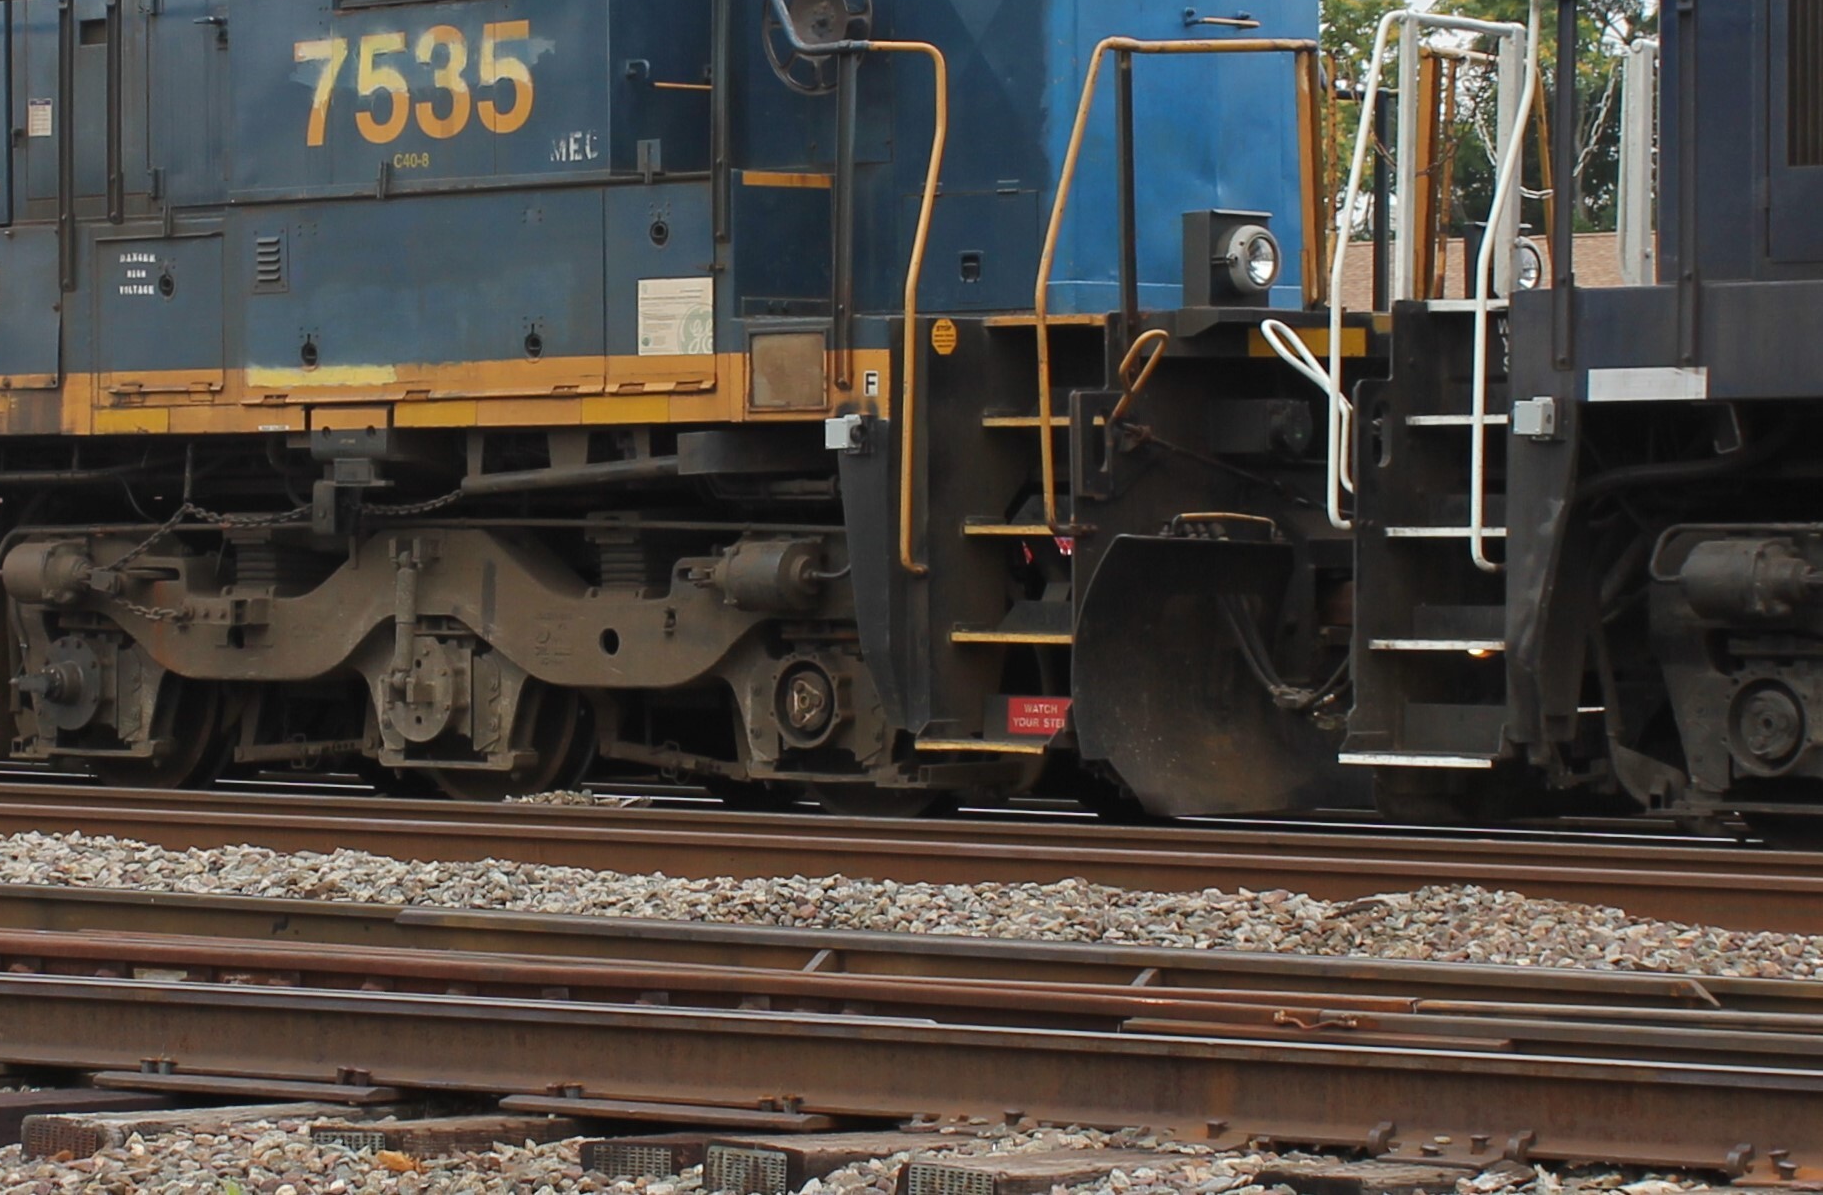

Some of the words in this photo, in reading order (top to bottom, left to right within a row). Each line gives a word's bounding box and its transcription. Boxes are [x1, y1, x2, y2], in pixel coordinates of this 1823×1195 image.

[292, 18, 535, 148] 7535
[549, 130, 599, 163] MEC
[393, 152, 430, 169] C40-8
[119, 252, 157, 264] DANGER
[119, 284, 155, 295] VOLTAGE
[865, 372, 878, 395] F
[1023, 703, 1059, 715] WATCH
[1012, 716, 1040, 728] YOUR
